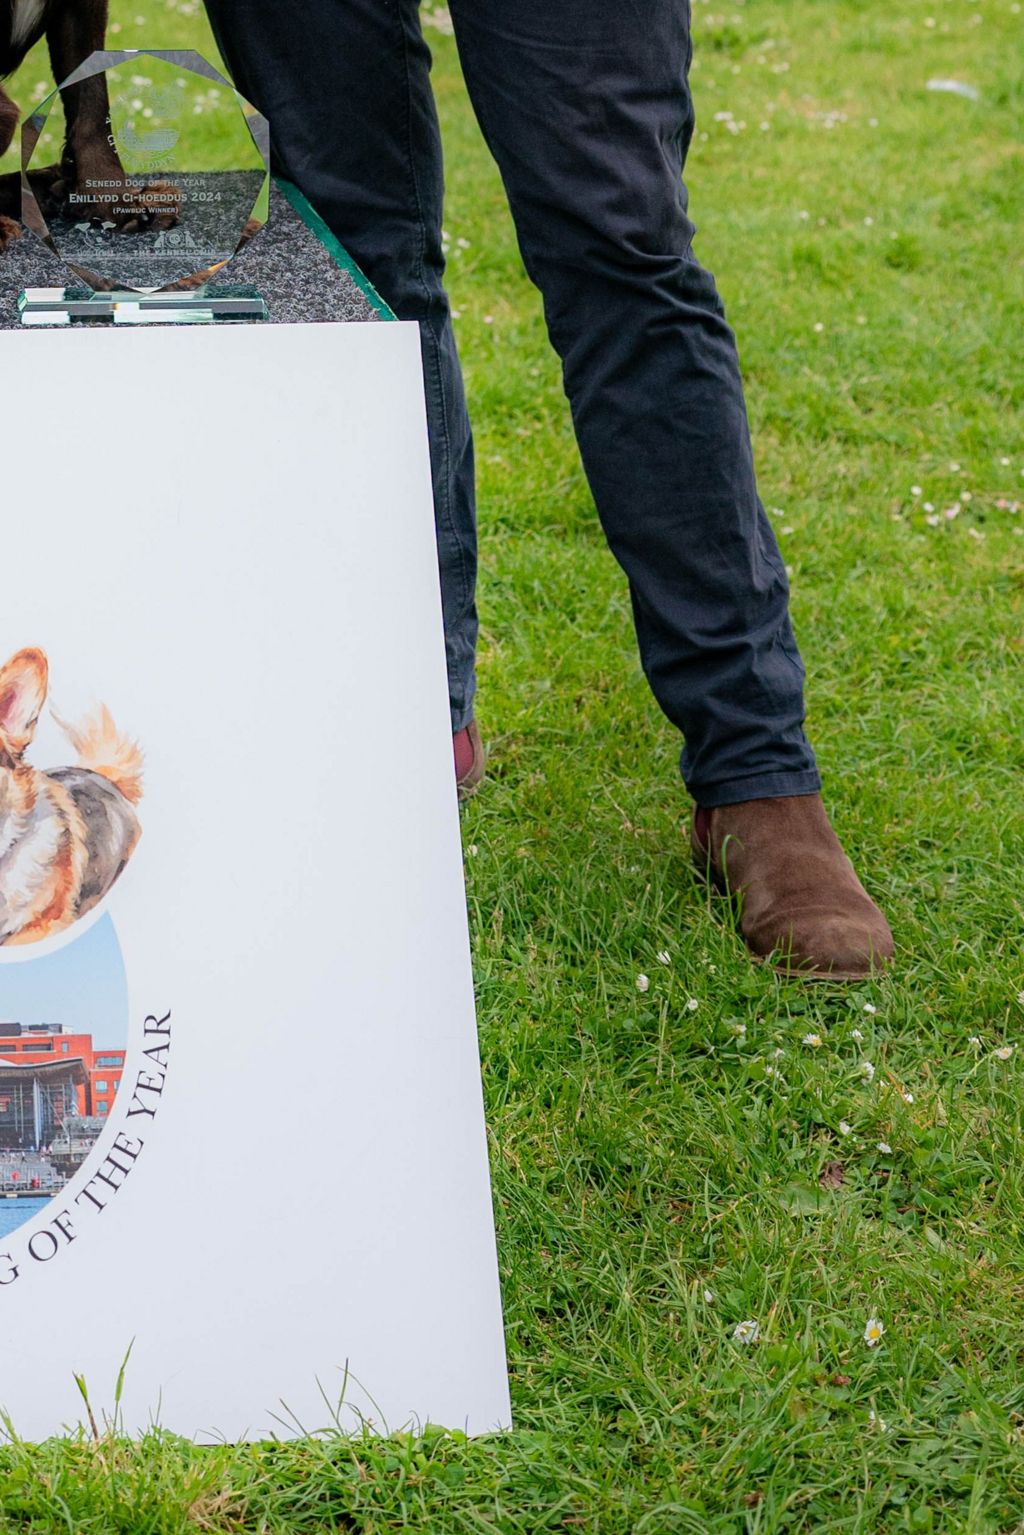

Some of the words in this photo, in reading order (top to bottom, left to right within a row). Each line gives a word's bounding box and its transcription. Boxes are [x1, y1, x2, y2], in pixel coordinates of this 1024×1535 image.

[85, 179, 122, 188] SENEDD
[125, 179, 145, 187] DOG
[182, 178, 206, 187] YEAR
[69, 193, 119, 203] ENILLYDD
[191, 192, 222, 202] 2024
[27, 1209, 78, 1263] OF
[74, 1131, 145, 1214] THE
[126, 1008, 172, 1121] YEAR
